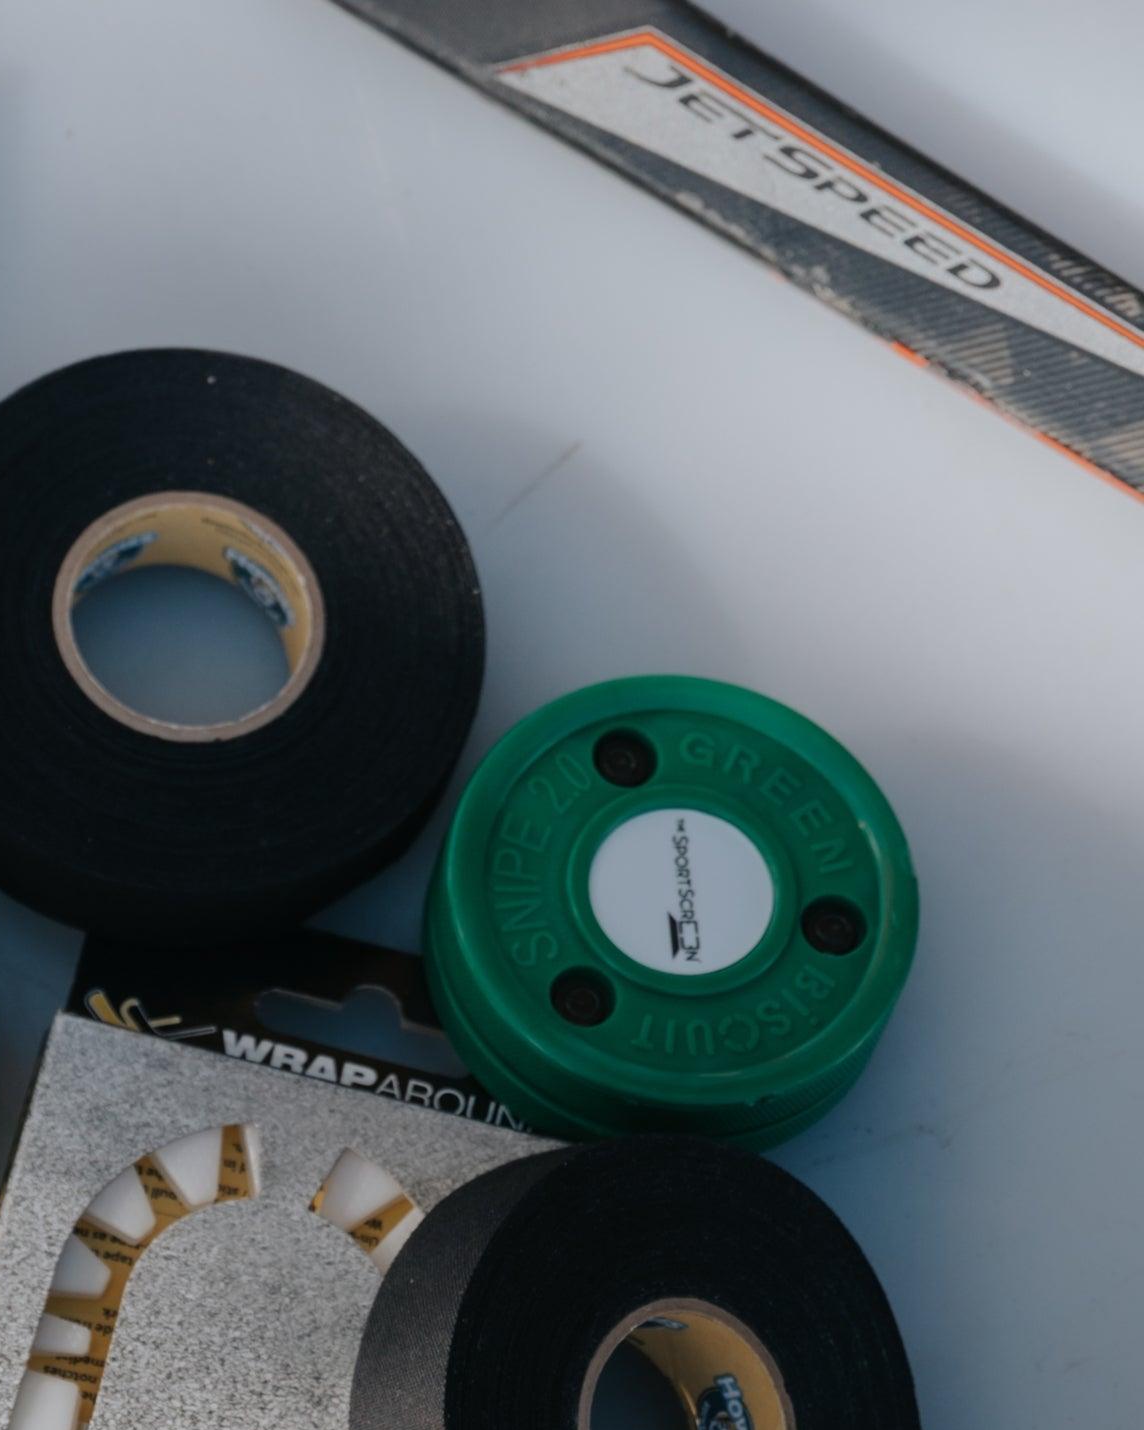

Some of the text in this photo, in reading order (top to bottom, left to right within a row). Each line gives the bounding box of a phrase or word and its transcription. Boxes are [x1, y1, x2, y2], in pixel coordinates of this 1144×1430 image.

[624, 65, 1003, 293] JETSPEED
[493, 753, 591, 967] SNIPE 2.0
[679, 732, 854, 873] GREEN
[223, 1029, 533, 1134] WRAPAROUN
